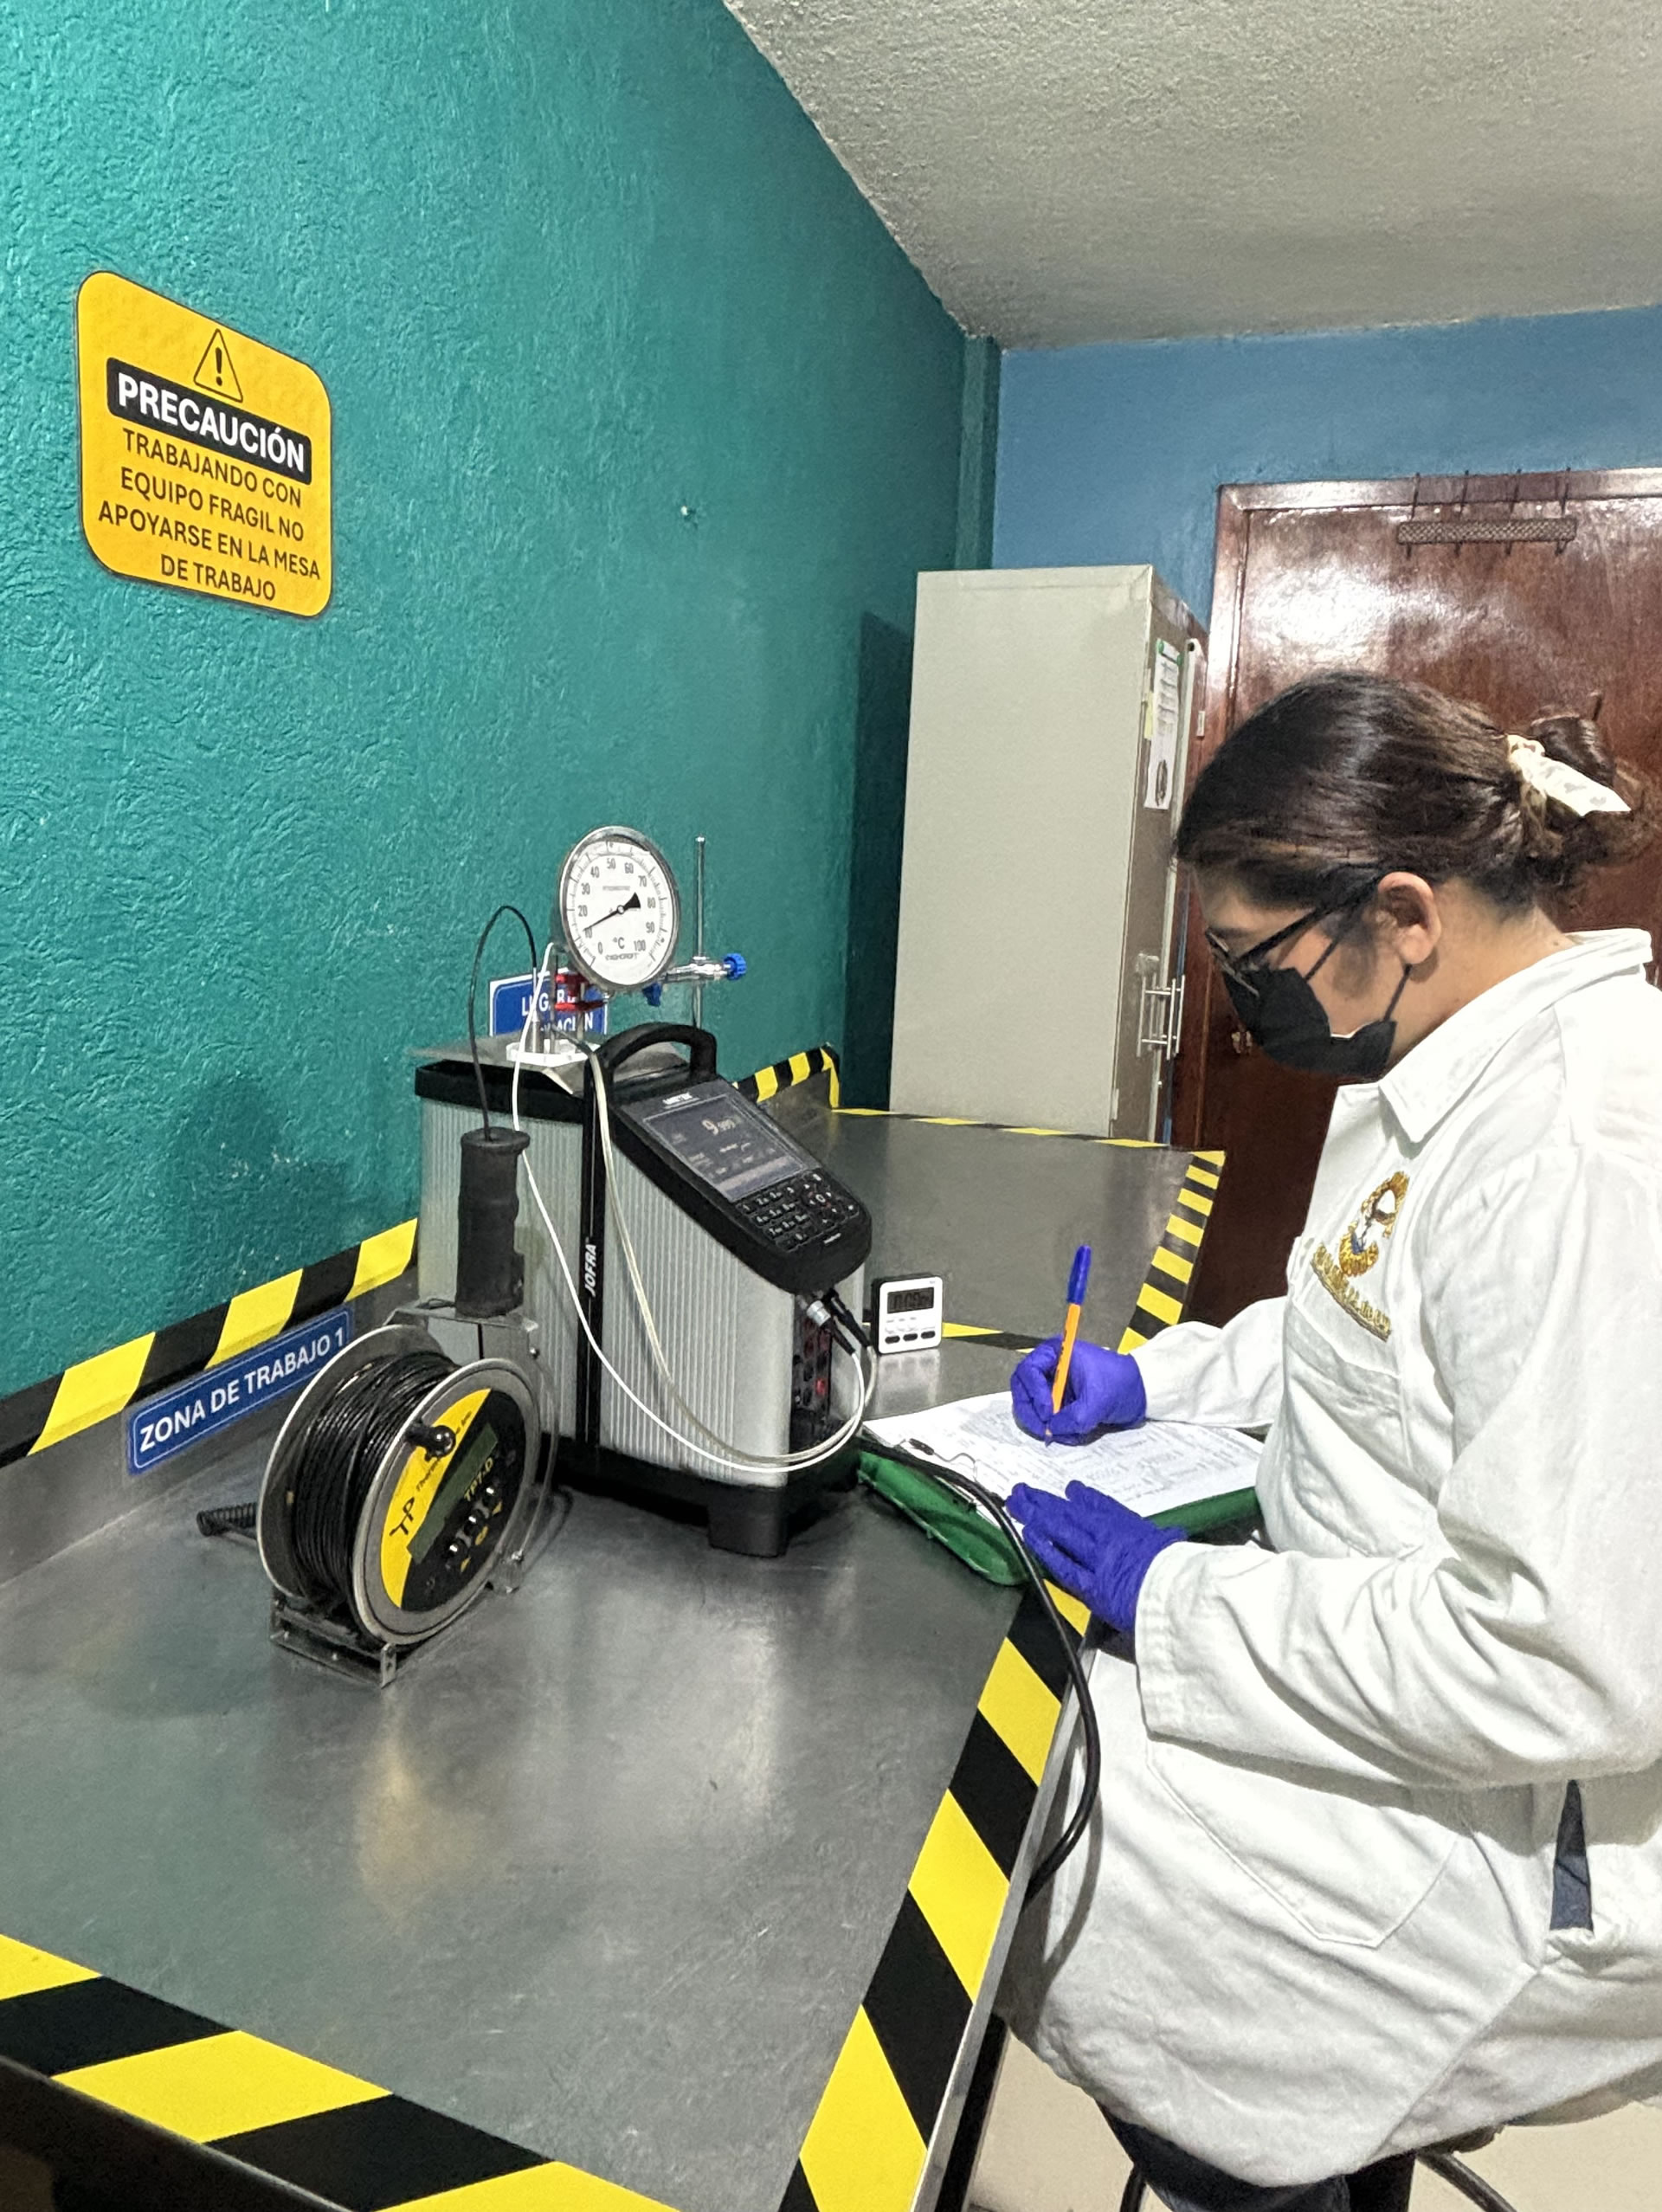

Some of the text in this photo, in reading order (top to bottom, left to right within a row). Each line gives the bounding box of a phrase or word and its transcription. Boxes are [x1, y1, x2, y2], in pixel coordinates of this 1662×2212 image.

[118, 373, 304, 473] PRECAUCIÓN
[123, 428, 301, 508] TRABAJANDO CON
[121, 467, 305, 541] EQUIPO FRAGIL NO
[99, 501, 320, 580] APOYARSE EN LA MESA
[161, 554, 276, 601] DE TRABAJO
[607, 858, 616, 869] 50
[624, 862, 634, 874] 60
[590, 866, 600, 879] 40
[638, 875, 647, 887] 70
[581, 883, 590, 895] 30
[578, 905, 588, 917] 20
[646, 921, 655, 933] 90
[597, 941, 603, 955] 0
[634, 939, 647, 951] 100
[522, 989, 565, 1017] LGR
[584, 1243, 597, 1298] JOFRA
[139, 1326, 344, 1453] ZONA DE TRABAJO 1
